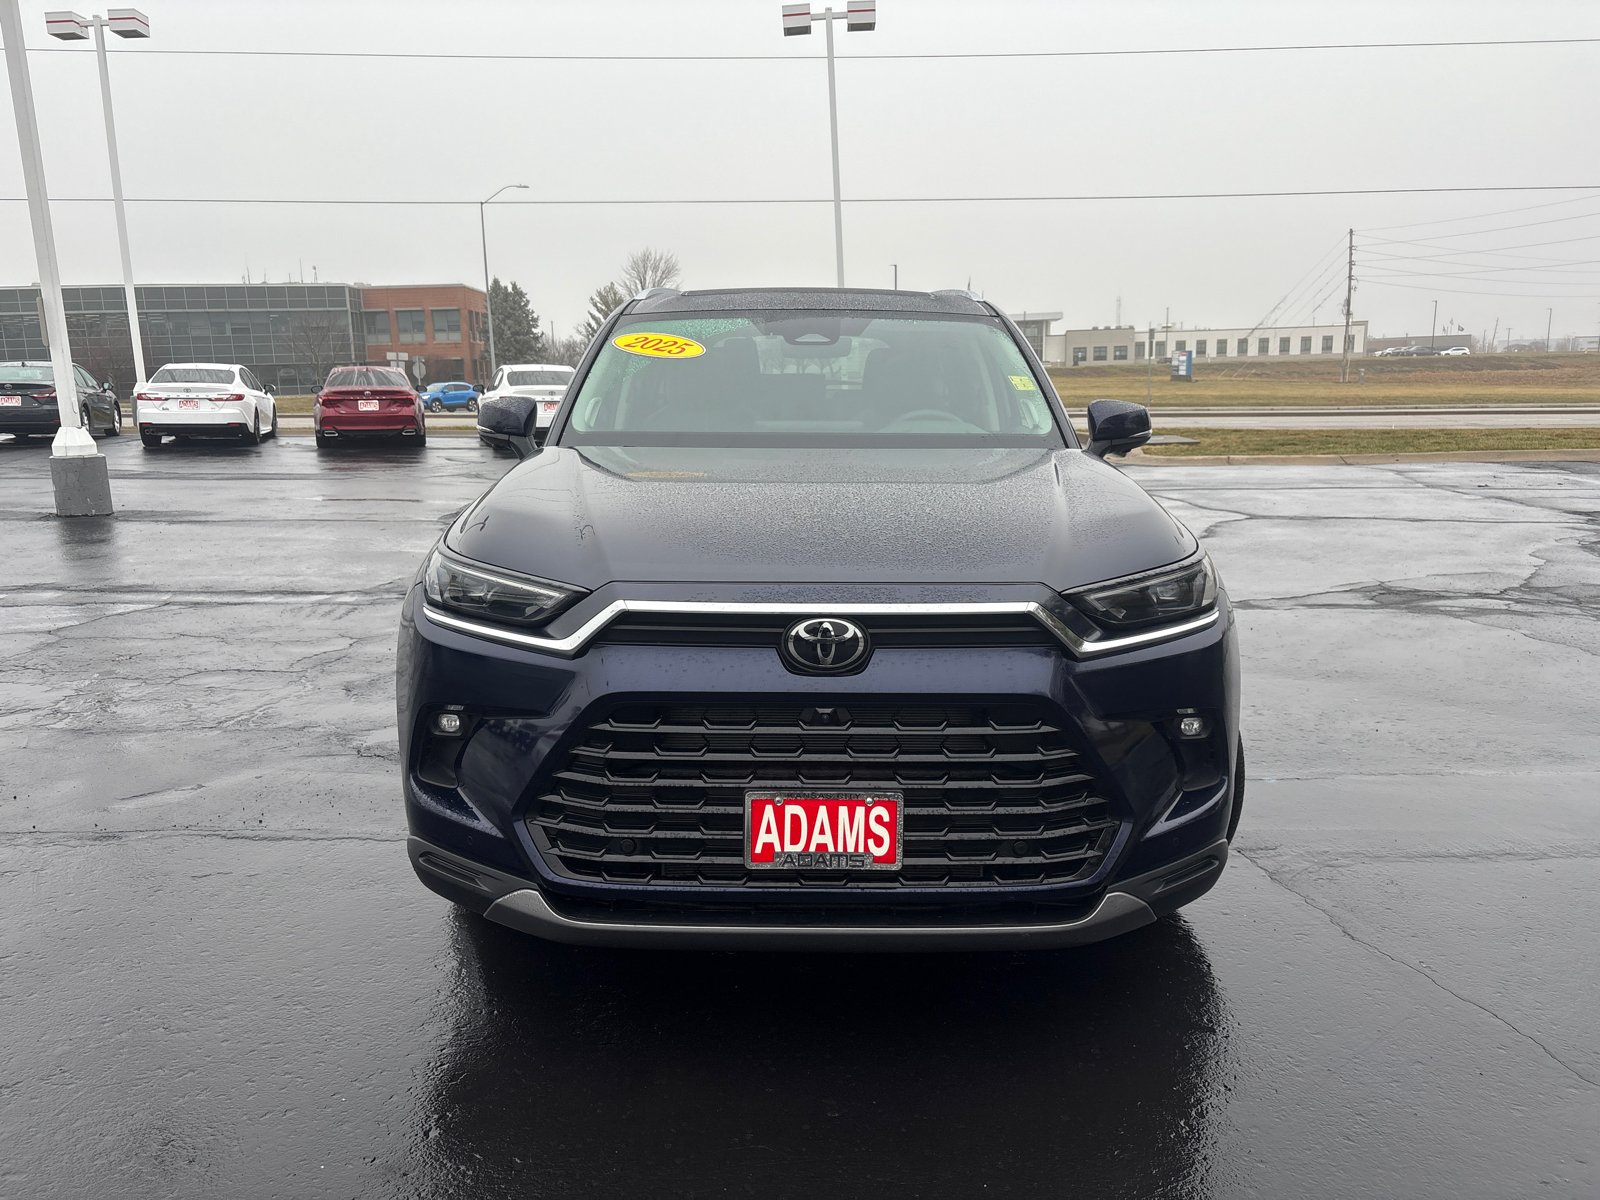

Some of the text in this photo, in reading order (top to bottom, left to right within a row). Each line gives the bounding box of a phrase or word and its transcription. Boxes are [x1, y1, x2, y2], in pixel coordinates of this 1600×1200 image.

[623, 336, 694, 355] 2025
[754, 804, 890, 857] ADAMS
[781, 853, 866, 868] ADAMS
